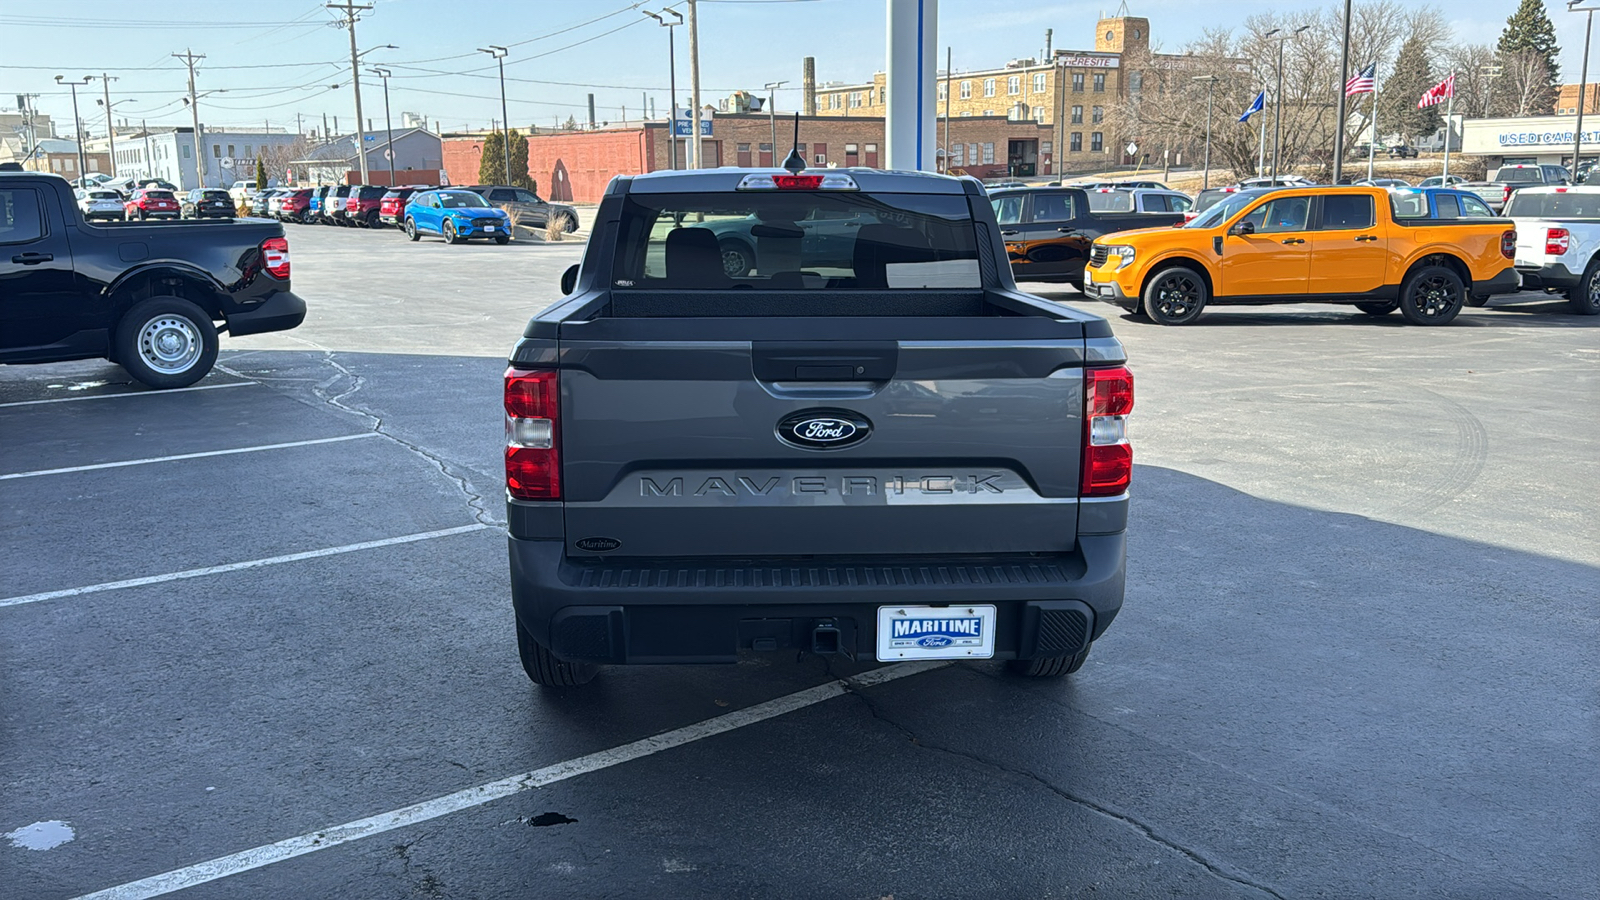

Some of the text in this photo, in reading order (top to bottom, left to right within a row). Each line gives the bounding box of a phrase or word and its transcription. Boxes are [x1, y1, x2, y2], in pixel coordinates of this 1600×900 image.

[1499, 133, 1537, 144] USED
[1543, 132, 1573, 143] CAR
[804, 421, 843, 438] Ford
[639, 475, 1003, 497] MAVERICK
[580, 540, 617, 548] Maritime
[894, 619, 980, 637] MARITIME
[922, 638, 947, 647] Ford
